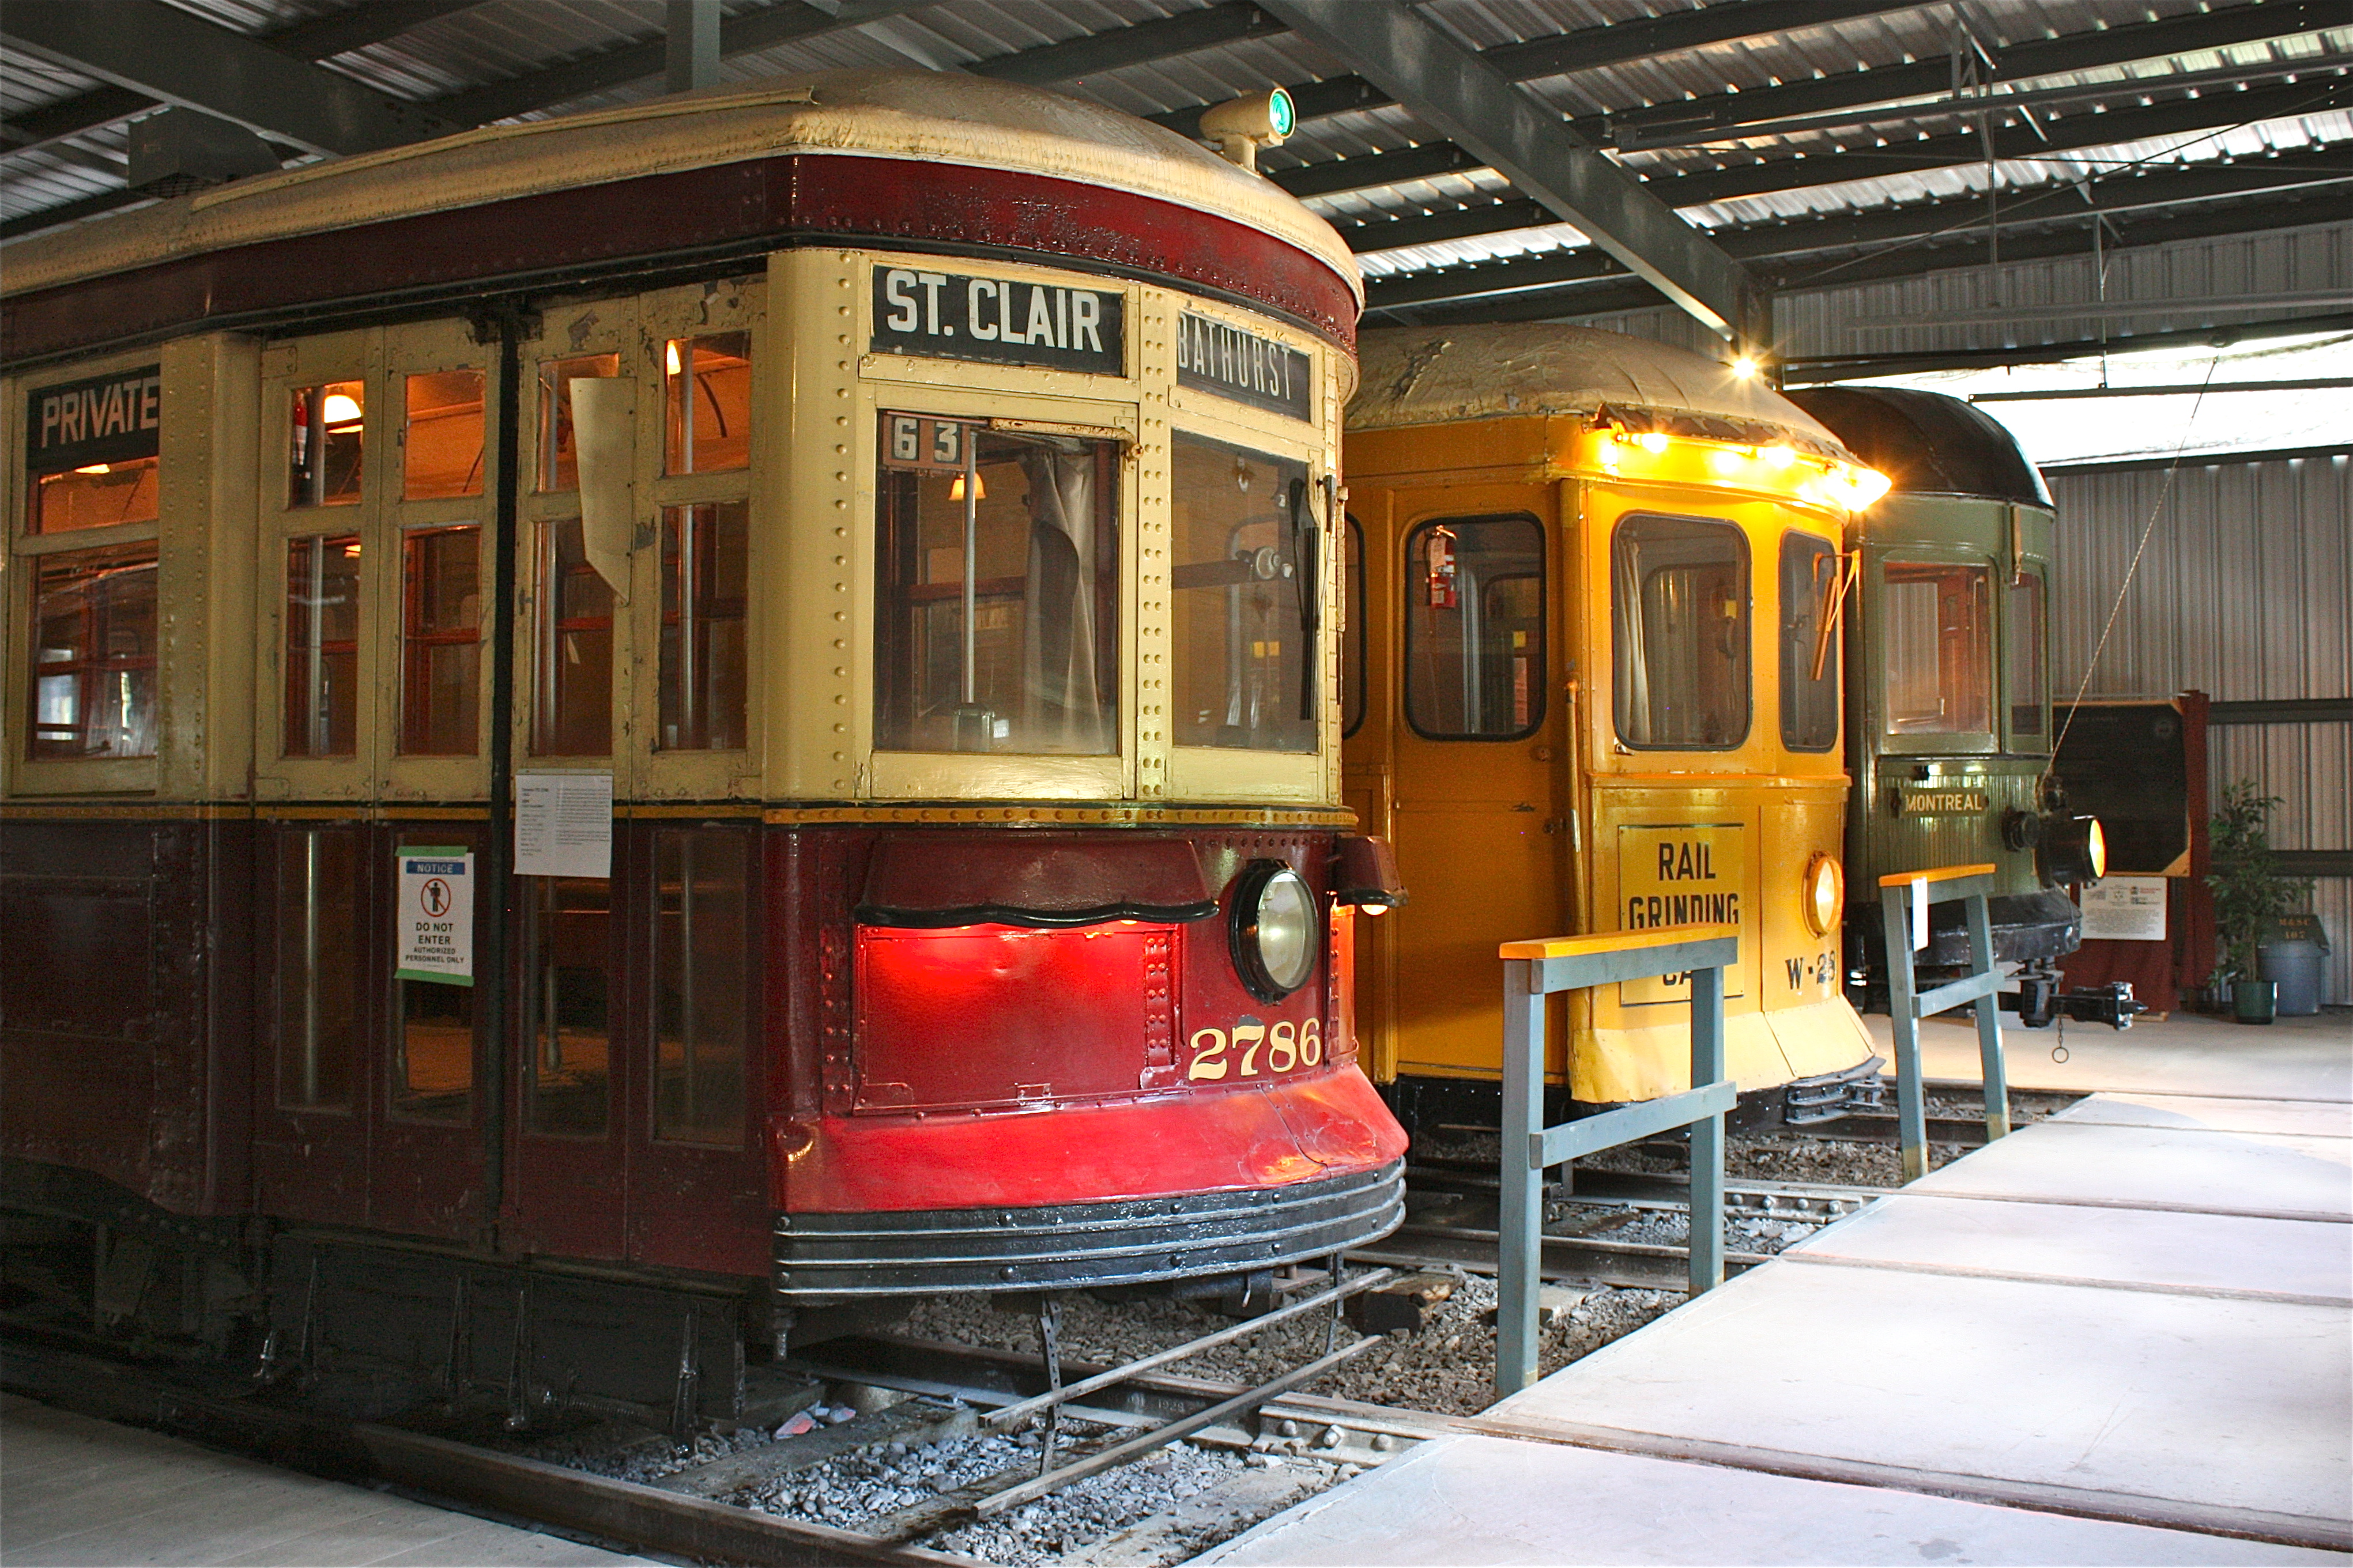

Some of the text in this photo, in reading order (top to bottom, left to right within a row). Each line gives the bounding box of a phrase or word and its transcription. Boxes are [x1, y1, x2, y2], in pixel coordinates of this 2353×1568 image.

[886, 269, 1103, 353] ST. CLAIR
[1177, 312, 1290, 400] BATHURST
[41, 376, 161, 449] PRIVATE
[1905, 794, 1983, 811] MONTREAL
[417, 863, 454, 874] NOTICE
[1658, 842, 1716, 881] RAIL
[1628, 893, 1739, 930] GRINDING
[416, 922, 454, 933] DO NOT
[418, 935, 451, 945] ENTER
[405, 954, 465, 964] PERSONNEL ONLY
[413, 946, 456, 955] AUTHORIZED
[1188, 1017, 1321, 1081] 2786
